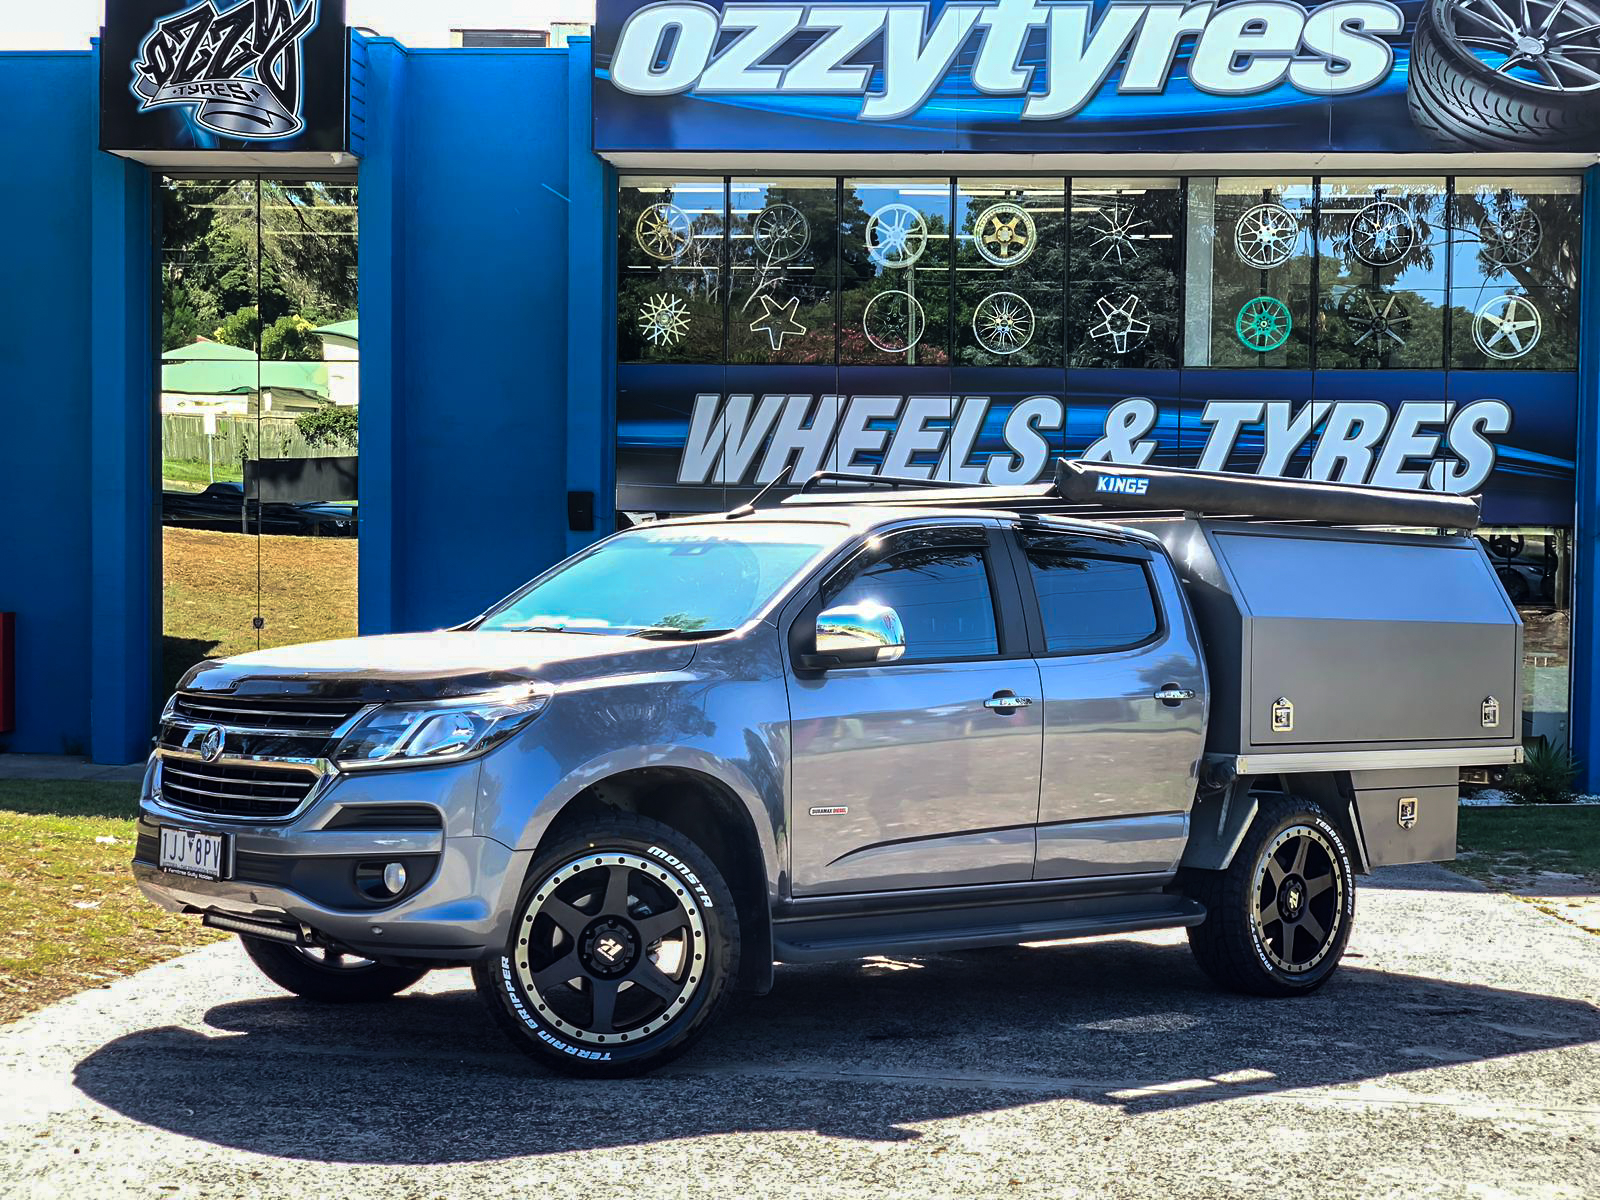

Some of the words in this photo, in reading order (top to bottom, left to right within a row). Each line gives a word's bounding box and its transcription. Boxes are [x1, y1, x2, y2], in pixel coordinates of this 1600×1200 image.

[609, 0, 1405, 121] ozzytyres
[178, 83, 249, 100] TYRES
[677, 393, 1064, 487] WHEELS
[1080, 397, 1157, 464] &
[1196, 399, 1512, 494] TYRES
[1097, 476, 1149, 494] KINGS
[1315, 817, 1346, 854] TERRAIN
[646, 846, 713, 908] MONSTA
[501, 955, 538, 1030] GRIPPER
[537, 1030, 612, 1061] TERRAIN
